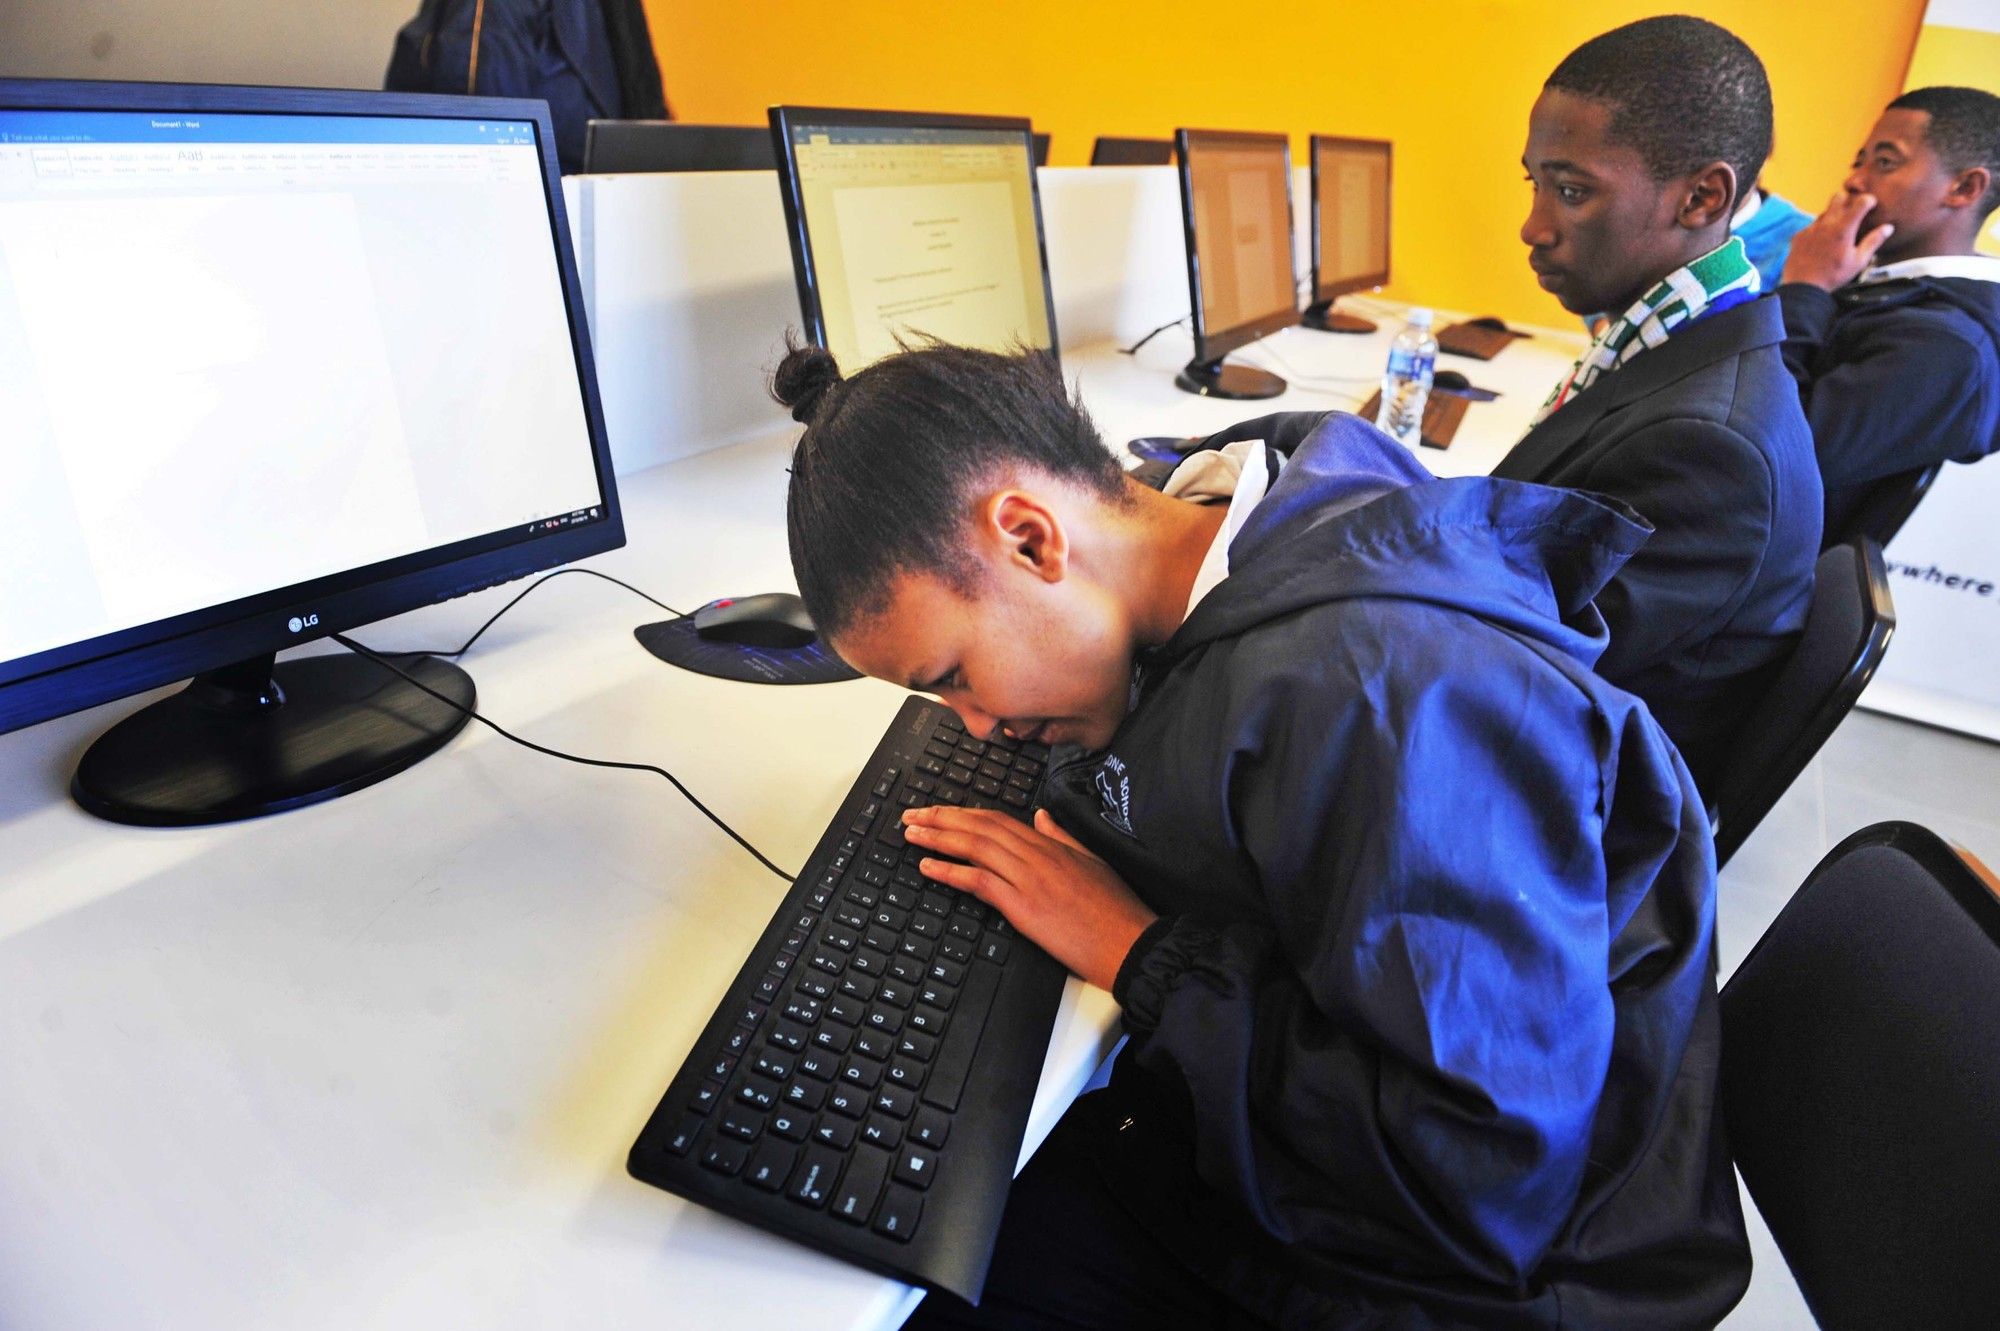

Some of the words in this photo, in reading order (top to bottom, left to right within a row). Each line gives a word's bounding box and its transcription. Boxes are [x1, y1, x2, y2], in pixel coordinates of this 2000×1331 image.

[303, 614, 319, 627] LG
[1104, 754, 1126, 776] ONE
[888, 893, 898, 903] P
[851, 917, 861, 925] 9
[878, 913, 890, 923] O
[839, 938, 850, 947] 8
[904, 943, 916, 953] K
[827, 961, 837, 969] 7
[856, 957, 868, 967] U
[894, 966, 905, 975] J
[933, 966, 946, 977] M
[815, 985, 826, 994] 6
[844, 981, 856, 990] Y
[883, 989, 895, 1000] H
[923, 991, 936, 1001] N
[801, 1010, 813, 1019] 5
[831, 1005, 843, 1015] T
[871, 1013, 885, 1024] G
[913, 1015, 926, 1026] B
[788, 1037, 798, 1046] 4
[818, 1032, 832, 1043] R
[859, 1040, 871, 1051] F
[902, 1041, 915, 1051] V
[772, 1065, 784, 1075] 3
[804, 1060, 818, 1071] E
[846, 1067, 860, 1079] D
[891, 1068, 905, 1079] C
[789, 1085, 805, 1099] W
[756, 1093, 770, 1104] 2
[833, 1097, 848, 1108] S
[879, 1096, 893, 1109] X
[775, 1118, 791, 1131] Q
[819, 1128, 833, 1139] A
[866, 1127, 881, 1139] Z
